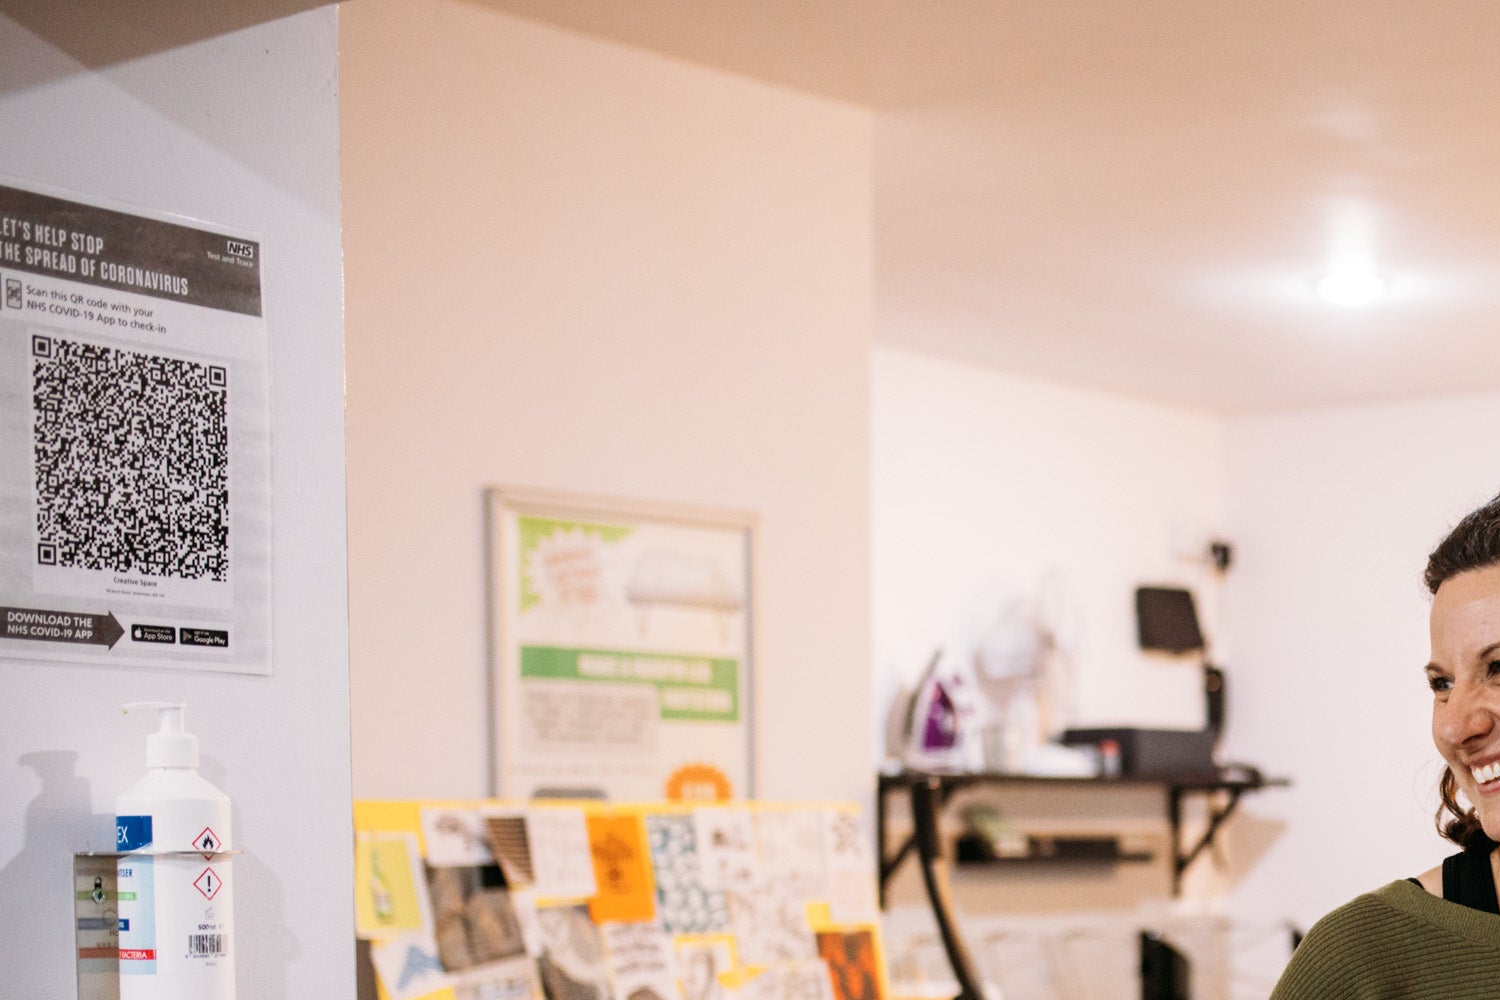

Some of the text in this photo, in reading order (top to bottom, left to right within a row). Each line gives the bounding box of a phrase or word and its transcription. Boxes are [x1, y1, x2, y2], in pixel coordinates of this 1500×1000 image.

[34, 224, 67, 248] HELP
[71, 231, 104, 255] STOP
[228, 242, 252, 257] NHS
[206, 250, 254, 268] Test and Trace
[25, 246, 76, 274] SPREAD
[80, 257, 96, 278] OF
[100, 261, 189, 296] CORONAVIRUS
[26, 285, 153, 318] Scan this QR code with your
[26, 300, 167, 335] NHS COVID-19 App to check-in
[113, 577, 158, 588] Creative Space
[7, 611, 93, 628] DOWNLOAD THE
[7, 624, 94, 640] NHS COVID-19 APP
[143, 632, 173, 641] App Store
[193, 635, 226, 646] Google Play
